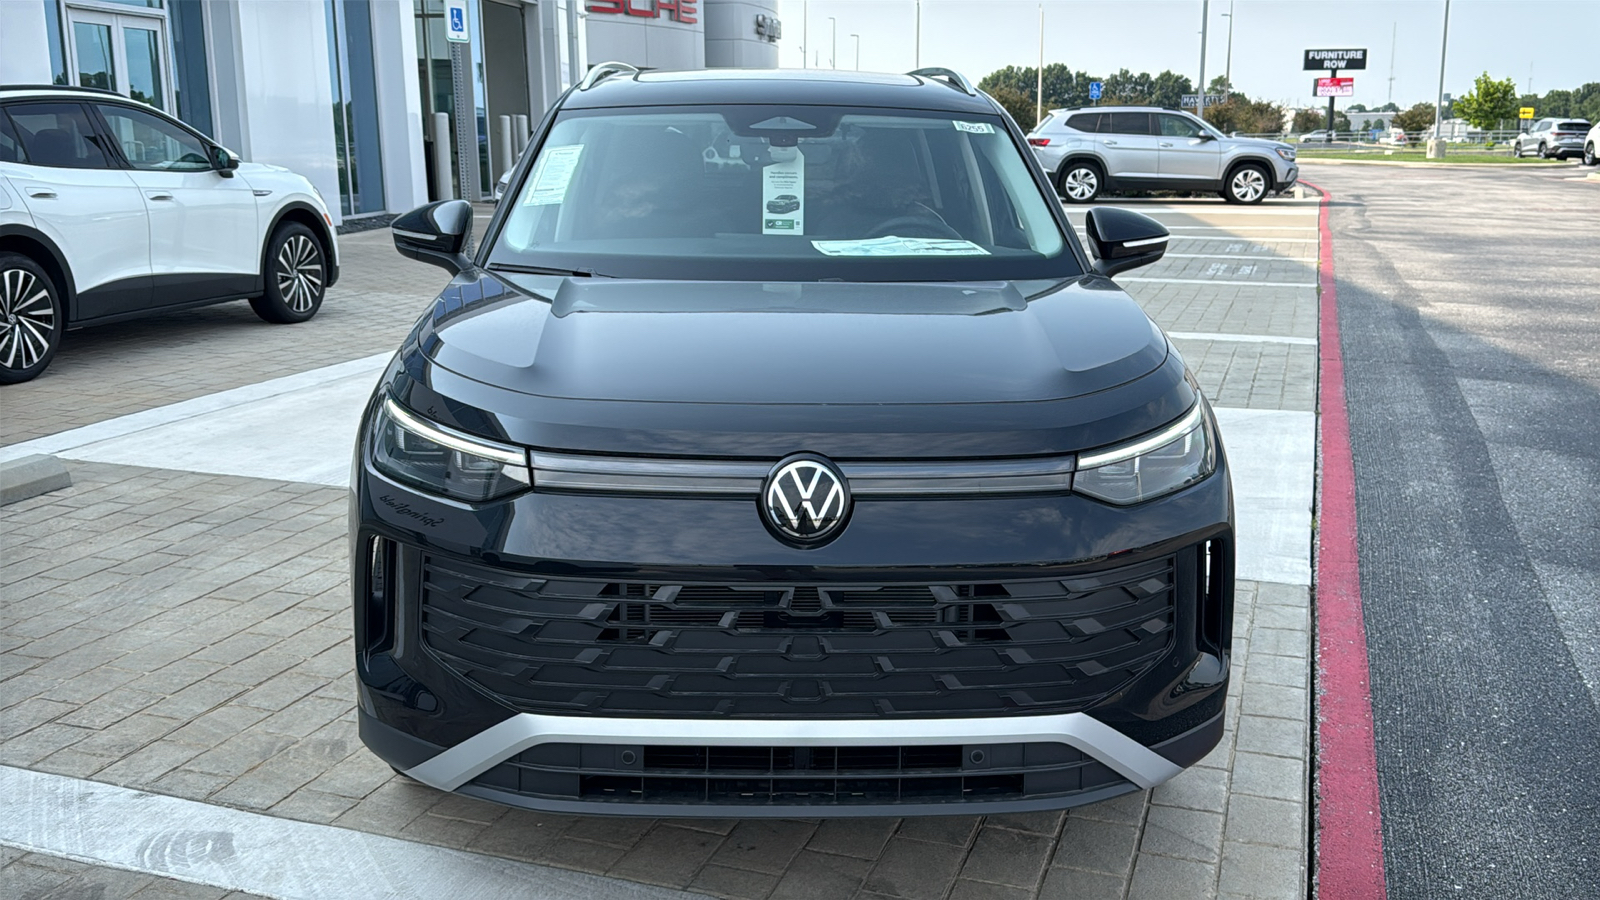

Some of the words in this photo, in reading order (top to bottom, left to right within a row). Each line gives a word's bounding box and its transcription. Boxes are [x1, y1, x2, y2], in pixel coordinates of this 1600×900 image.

[1308, 51, 1363, 60] FURNITURE
[1323, 60, 1347, 69] ROW
[768, 461, 844, 537] VW
